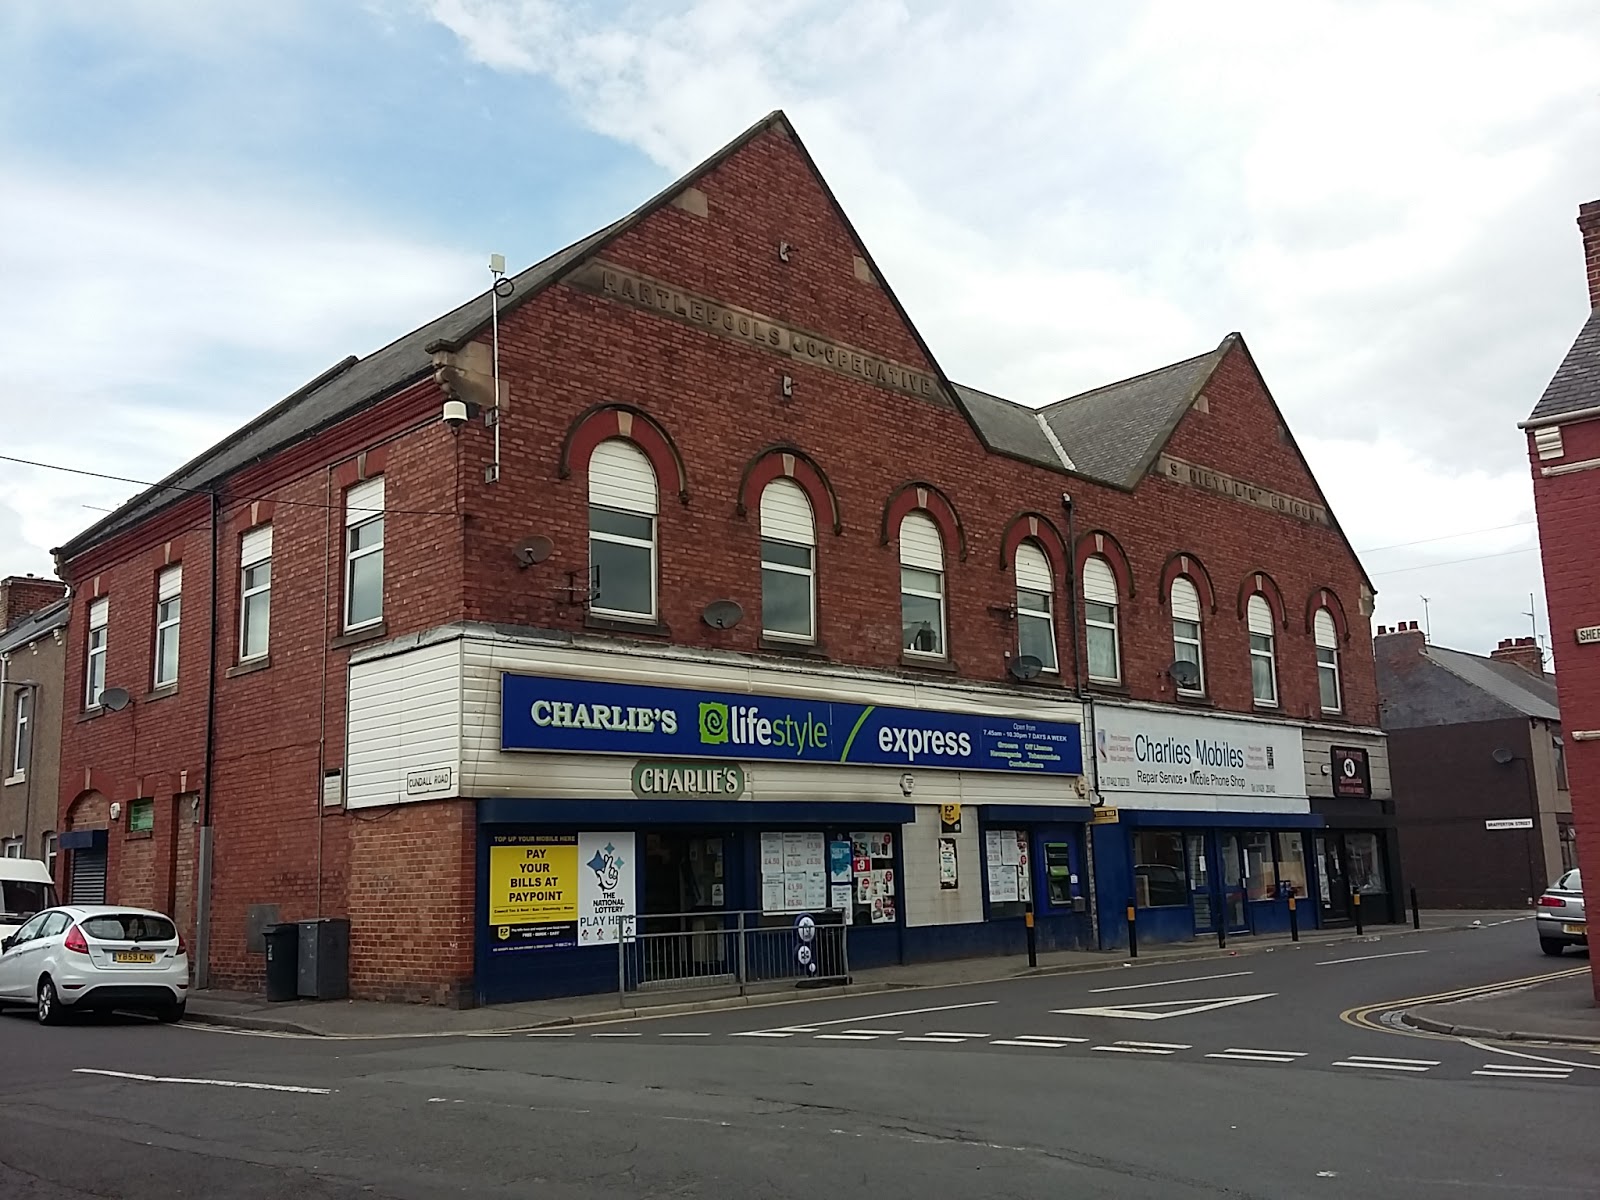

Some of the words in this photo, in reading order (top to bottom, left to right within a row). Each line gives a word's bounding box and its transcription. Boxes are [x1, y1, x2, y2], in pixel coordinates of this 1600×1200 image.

[602, 271, 780, 346] HARTLEPOOLS
[531, 700, 678, 735] CHARLIE'S
[731, 705, 828, 756] lifestyle
[878, 725, 971, 761] express
[1134, 734, 1192, 765] Charlies
[1195, 739, 1244, 769] Mobiles
[434, 773, 449, 785] ROAD
[639, 767, 738, 796] CHARLIE'S
[1137, 770, 1158, 784] Repair
[1159, 771, 1183, 785] Service
[1189, 772, 1210, 786] Mobile
[1210, 774, 1230, 787] Phone
[1230, 775, 1246, 789] Shop
[526, 849, 547, 859] PAY
[519, 863, 550, 873] YOUR
[510, 878, 542, 888] BILLS
[544, 877, 559, 887] AT
[509, 891, 563, 902] PAYPOINT
[593, 898, 625, 907] NATIONAL
[595, 906, 623, 914] LOTTERY
[580, 915, 605, 927] PLAY
[117, 953, 138, 961] YB59
[139, 953, 155, 961] CNK
